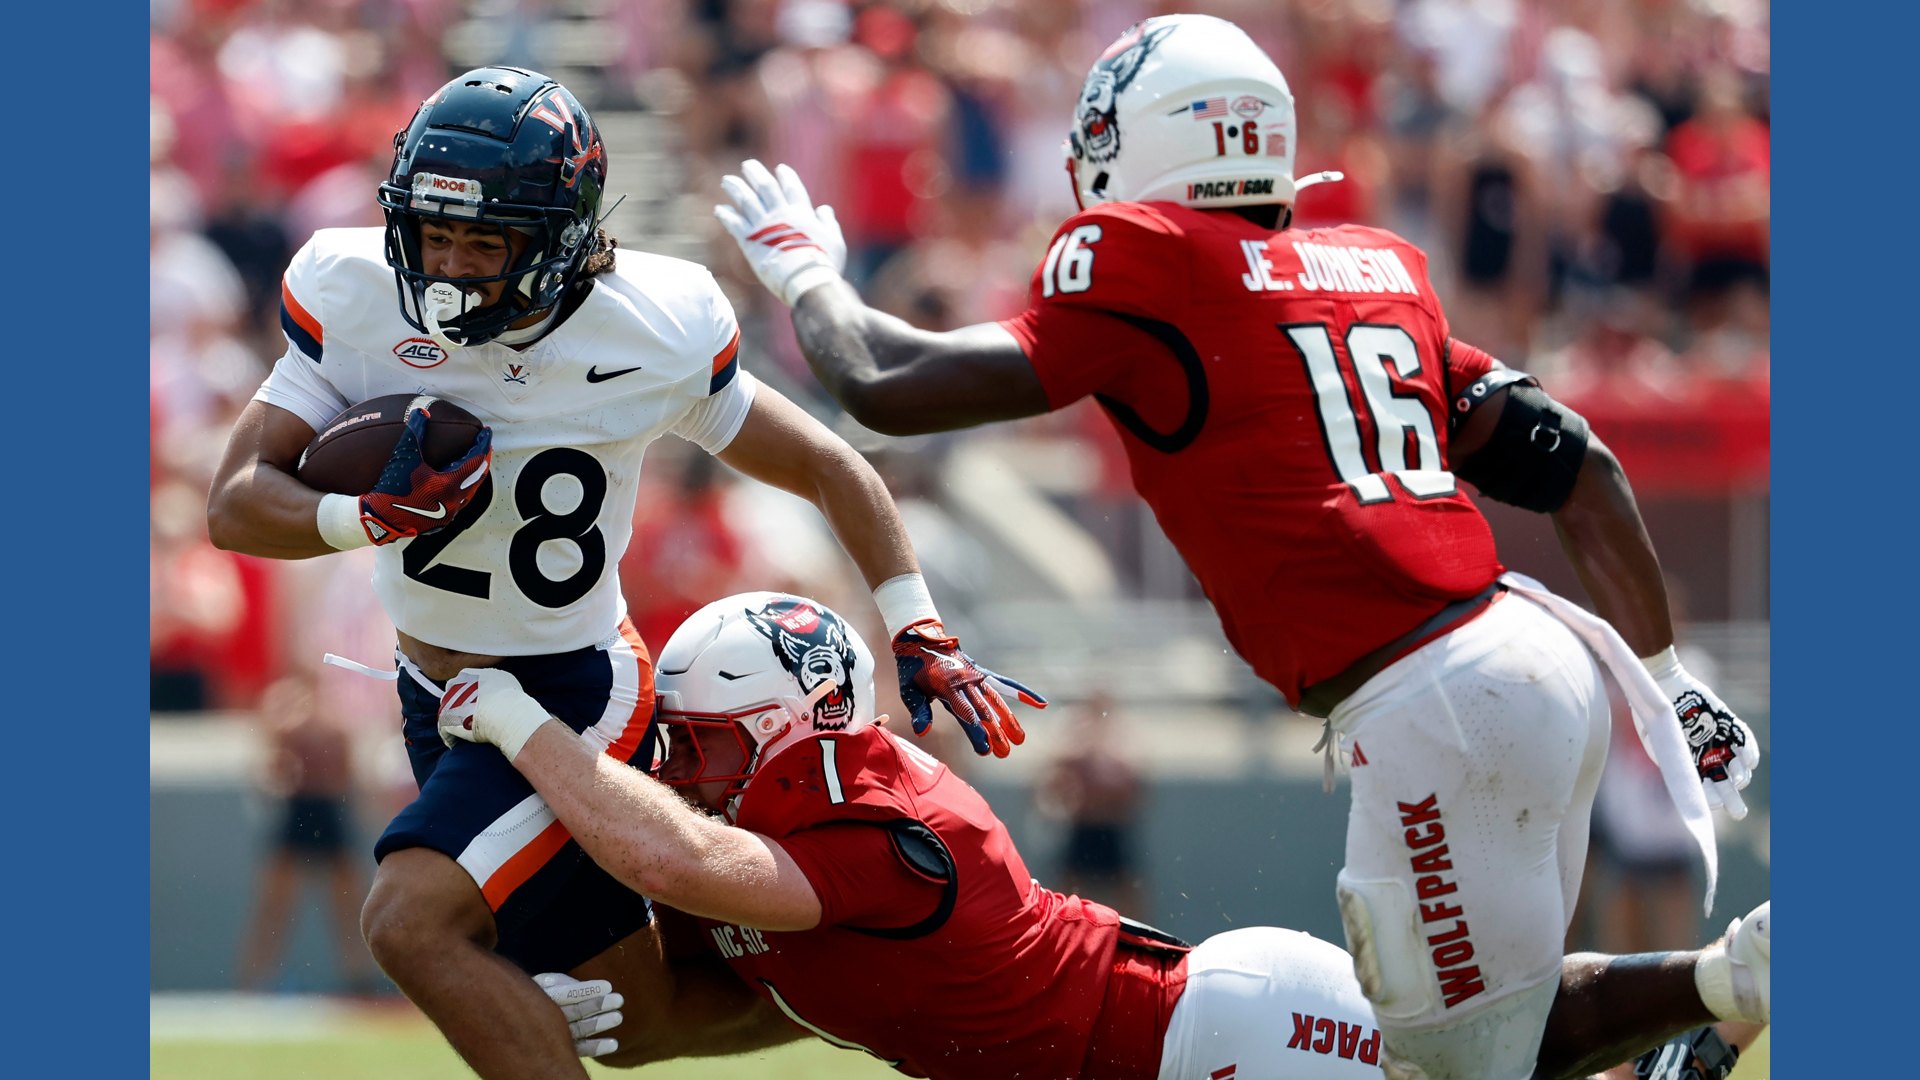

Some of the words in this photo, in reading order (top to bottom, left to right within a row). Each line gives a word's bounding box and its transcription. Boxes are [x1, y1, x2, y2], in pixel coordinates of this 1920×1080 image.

[1042, 223, 1103, 299] 16
[1240, 240, 1294, 292] JE.
[1292, 241, 1419, 296] JOHNSON
[401, 344, 441, 358] ACC
[1276, 321, 1458, 506] 16
[402, 447, 607, 609] 28
[782, 619, 800, 630] NC
[795, 608, 817, 626] STATE
[816, 737, 846, 805] 1
[1397, 792, 1485, 1009] WOLFPACK
[710, 924, 744, 959] NC
[567, 985, 601, 999] ADIZERO
[1286, 1011, 1382, 1068] PACK
